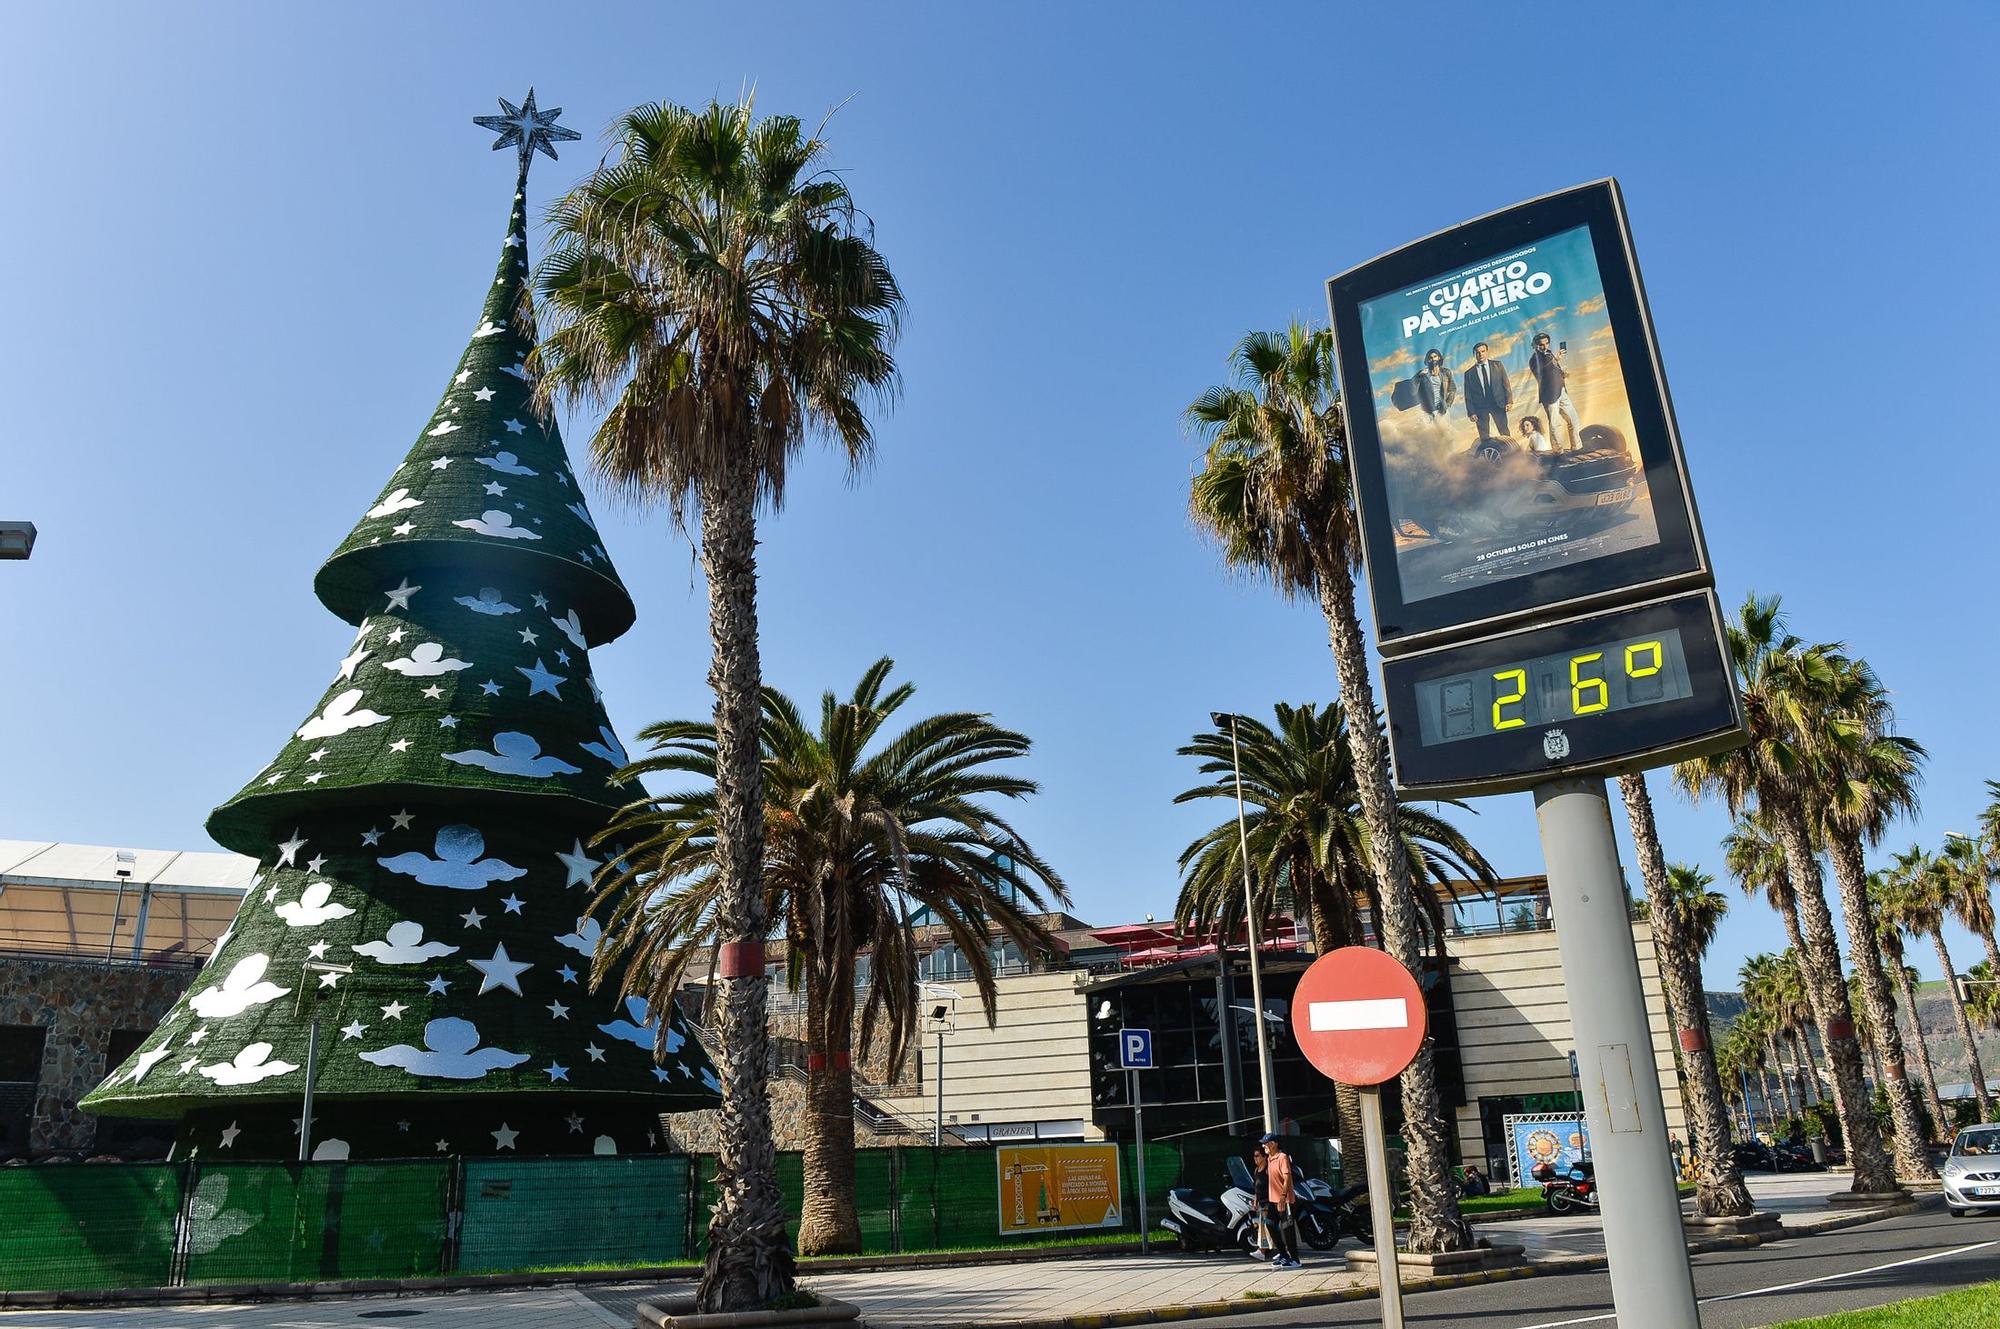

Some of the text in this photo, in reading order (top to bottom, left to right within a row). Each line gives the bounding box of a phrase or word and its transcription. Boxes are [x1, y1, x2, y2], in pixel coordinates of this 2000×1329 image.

[1461, 263, 1491, 277] PERFECTOS
[1491, 247, 1537, 267] DESCONOCIDOS
[1402, 271, 1552, 339] PASAJERO
[1422, 304, 1431, 312] EL
[1498, 305, 1520, 316] IGLESIA
[1476, 533, 1569, 562] 28 OCTUBRE SOLO EN CINES
[1127, 1034, 1145, 1062] P
[992, 1126, 1034, 1137] GRANIER
